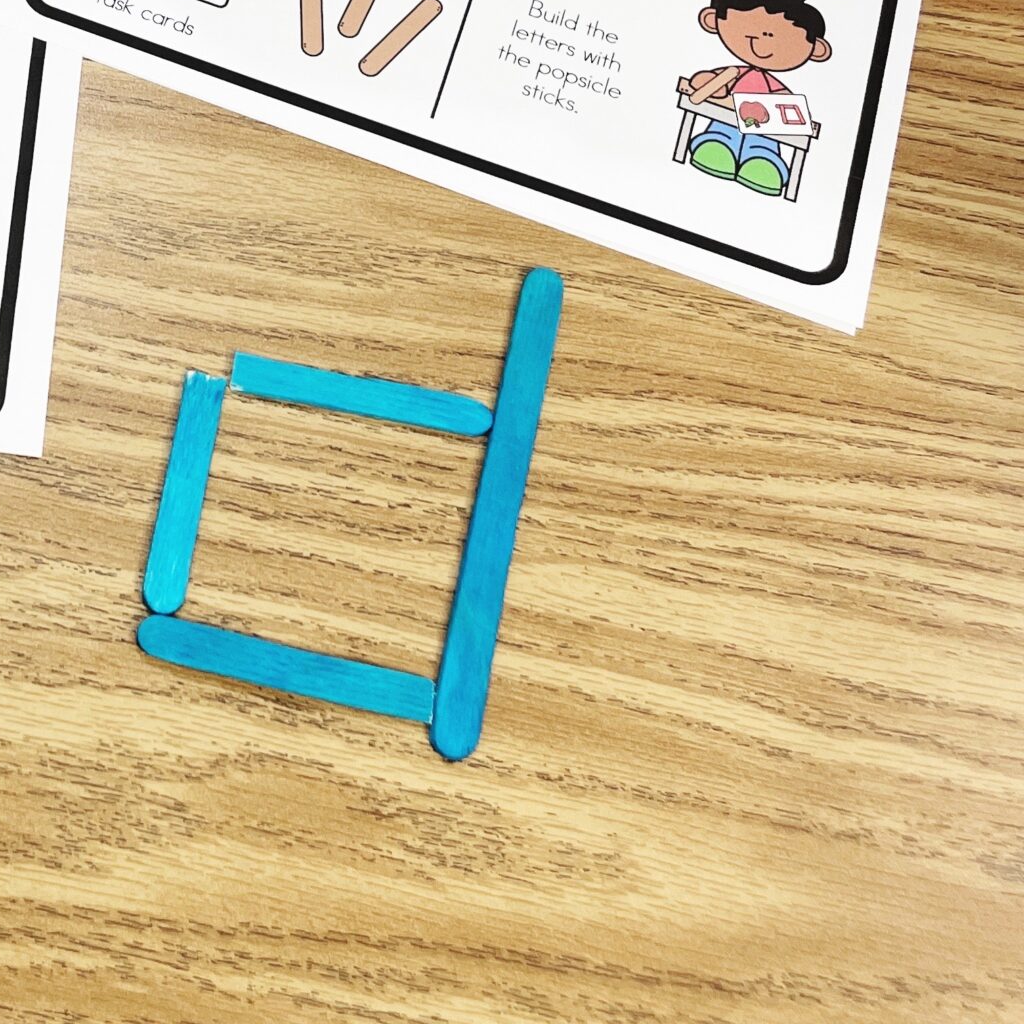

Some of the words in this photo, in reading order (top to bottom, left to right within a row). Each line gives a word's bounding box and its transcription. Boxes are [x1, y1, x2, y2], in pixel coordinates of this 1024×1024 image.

[140, 7, 195, 36] cards
[586, 20, 619, 44] the
[511, 19, 576, 57] letters
[583, 50, 622, 73] with
[498, 44, 531, 68] the
[535, 62, 622, 99] popsicle
[521, 83, 579, 114] sticks.
